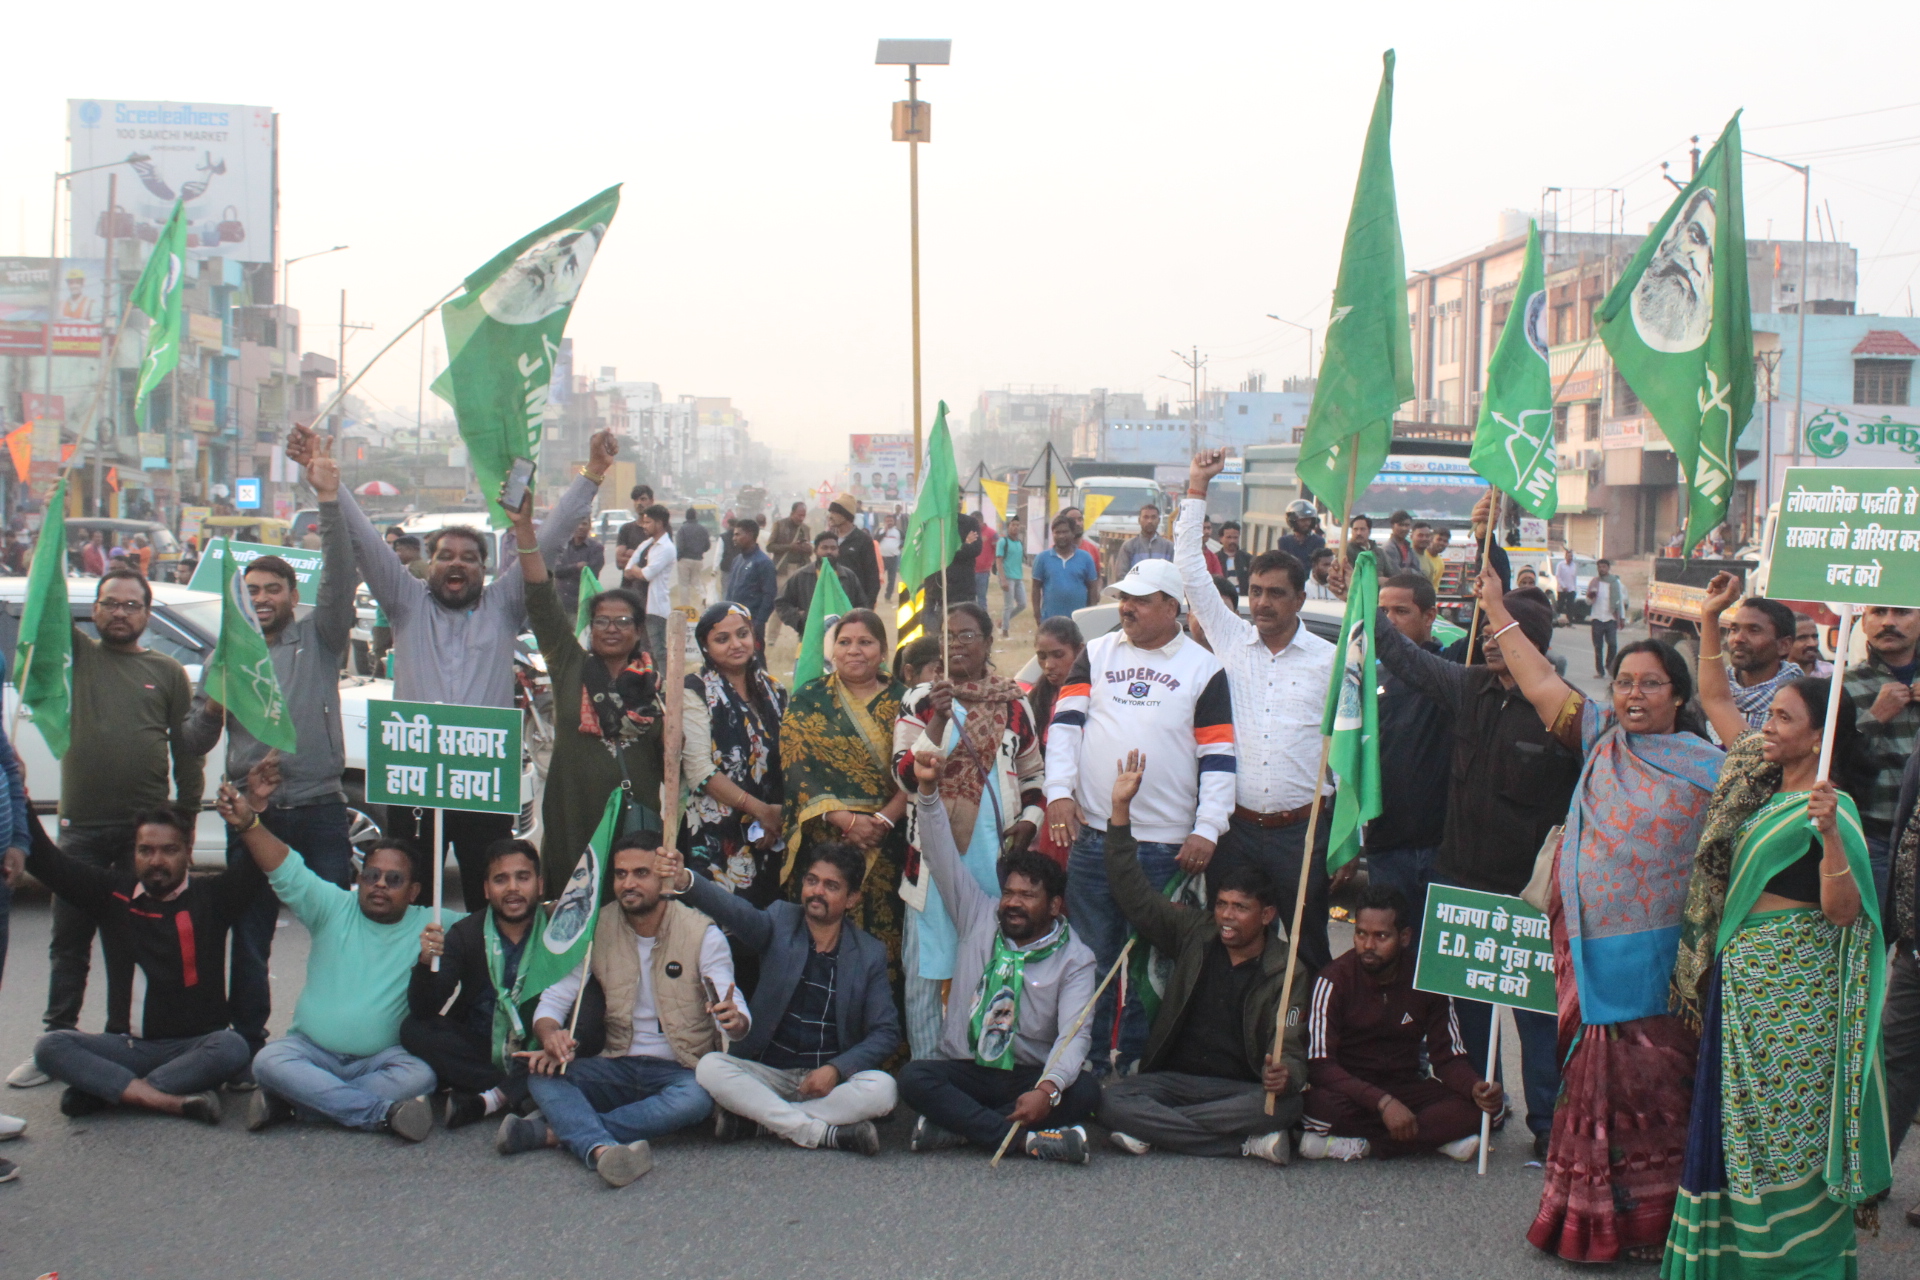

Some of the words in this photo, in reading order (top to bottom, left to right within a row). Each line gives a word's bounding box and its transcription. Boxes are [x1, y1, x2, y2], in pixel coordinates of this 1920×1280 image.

[116, 129, 136, 140] 100
[139, 129, 180, 141] SAKCHI
[183, 131, 229, 143] MARKET
[1904, 486, 1919, 515] से
[1786, 527, 1830, 549] सरकार
[1829, 521, 1850, 550] को
[1851, 523, 1900, 551] अस्थिर
[1826, 564, 1854, 586] बन्द
[1854, 559, 1883, 587] करो
[1105, 667, 1181, 691] SUPERIOR
[1112, 696, 1128, 704] NEW
[381, 711, 433, 753] मोदी
[436, 725, 509, 759] सरकार
[385, 764, 429, 797] हाय
[1436, 902, 1491, 930] भाजपा
[1491, 906, 1510, 932] के
[1511, 913, 1551, 940] इशारे
[1437, 930, 1470, 959] E.D.
[1474, 937, 1498, 963] की
[1500, 940, 1533, 973] गुंडा
[1465, 968, 1498, 992] बन्द
[1498, 971, 1531, 998] करो
